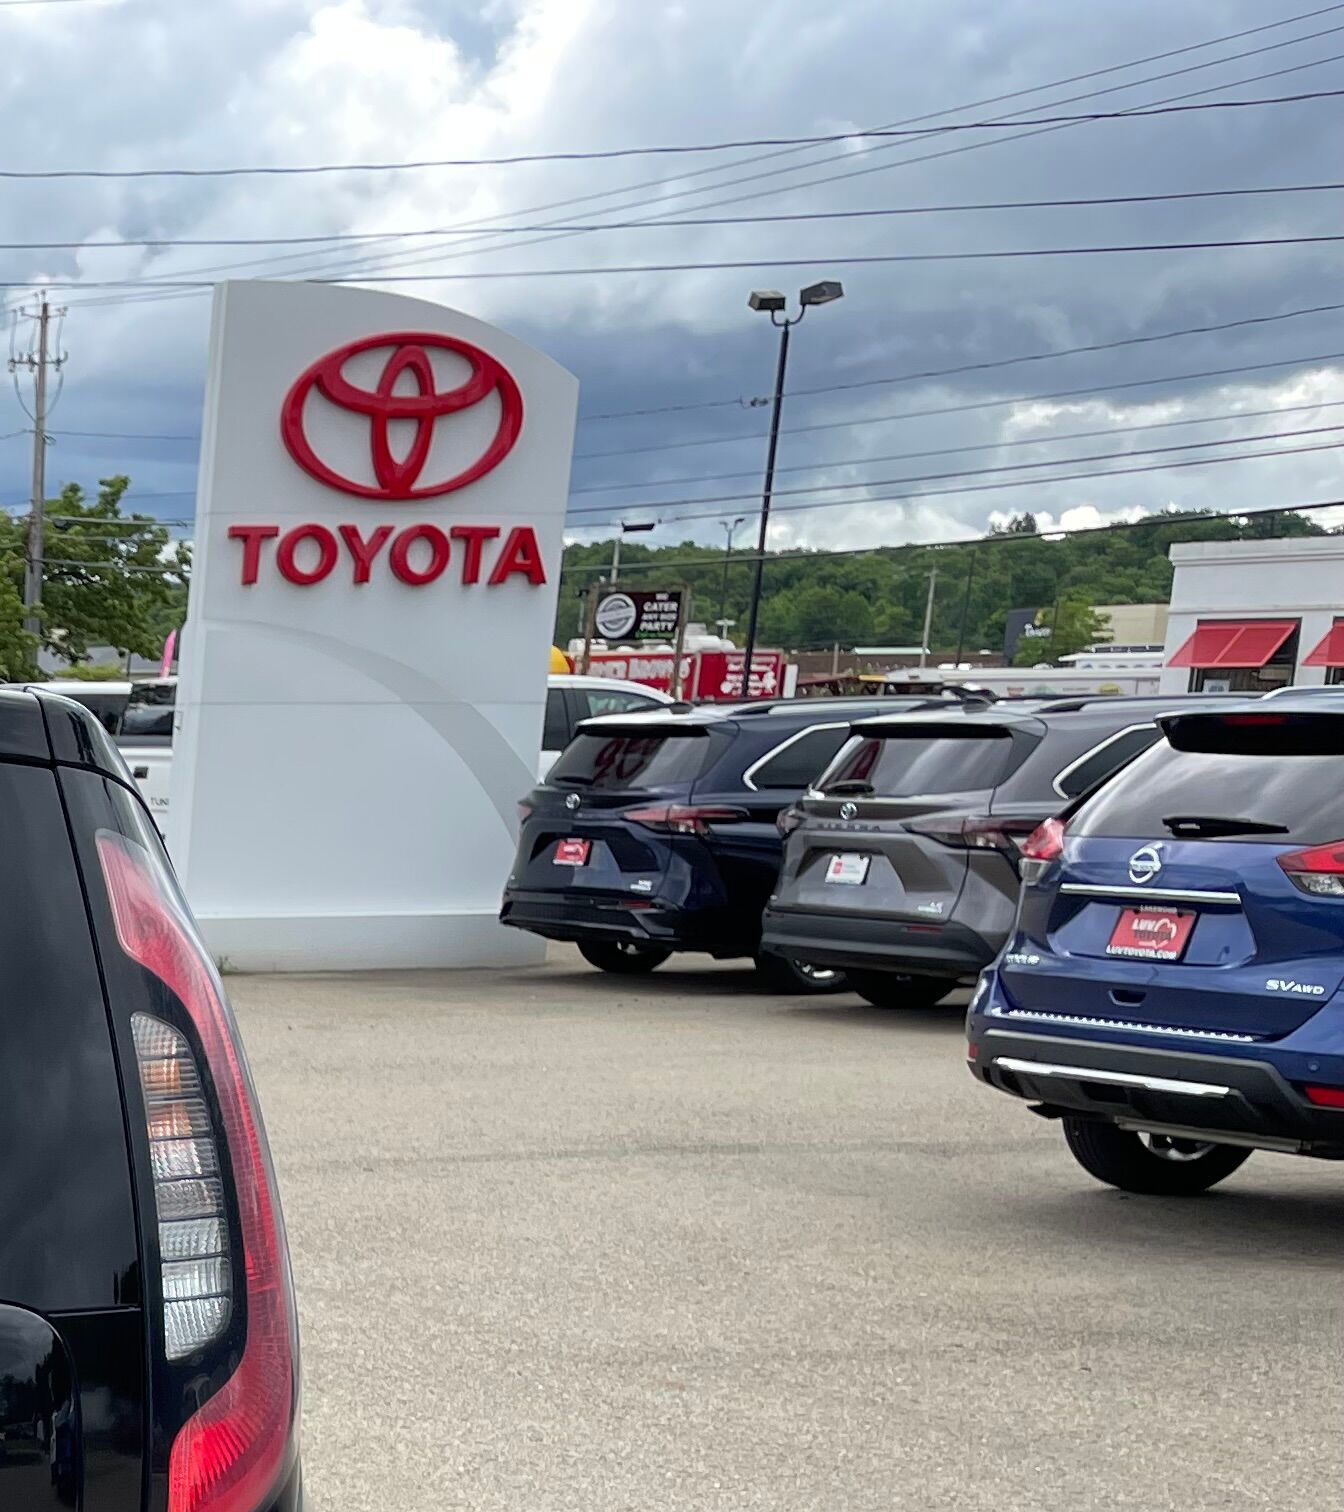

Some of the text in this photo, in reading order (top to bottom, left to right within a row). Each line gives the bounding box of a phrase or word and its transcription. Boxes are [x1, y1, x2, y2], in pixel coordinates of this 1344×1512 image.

[227, 523, 547, 586] TOYOTA
[643, 602, 678, 611] CATER
[639, 621, 675, 631] PARTY
[1132, 918, 1155, 931] LUV
